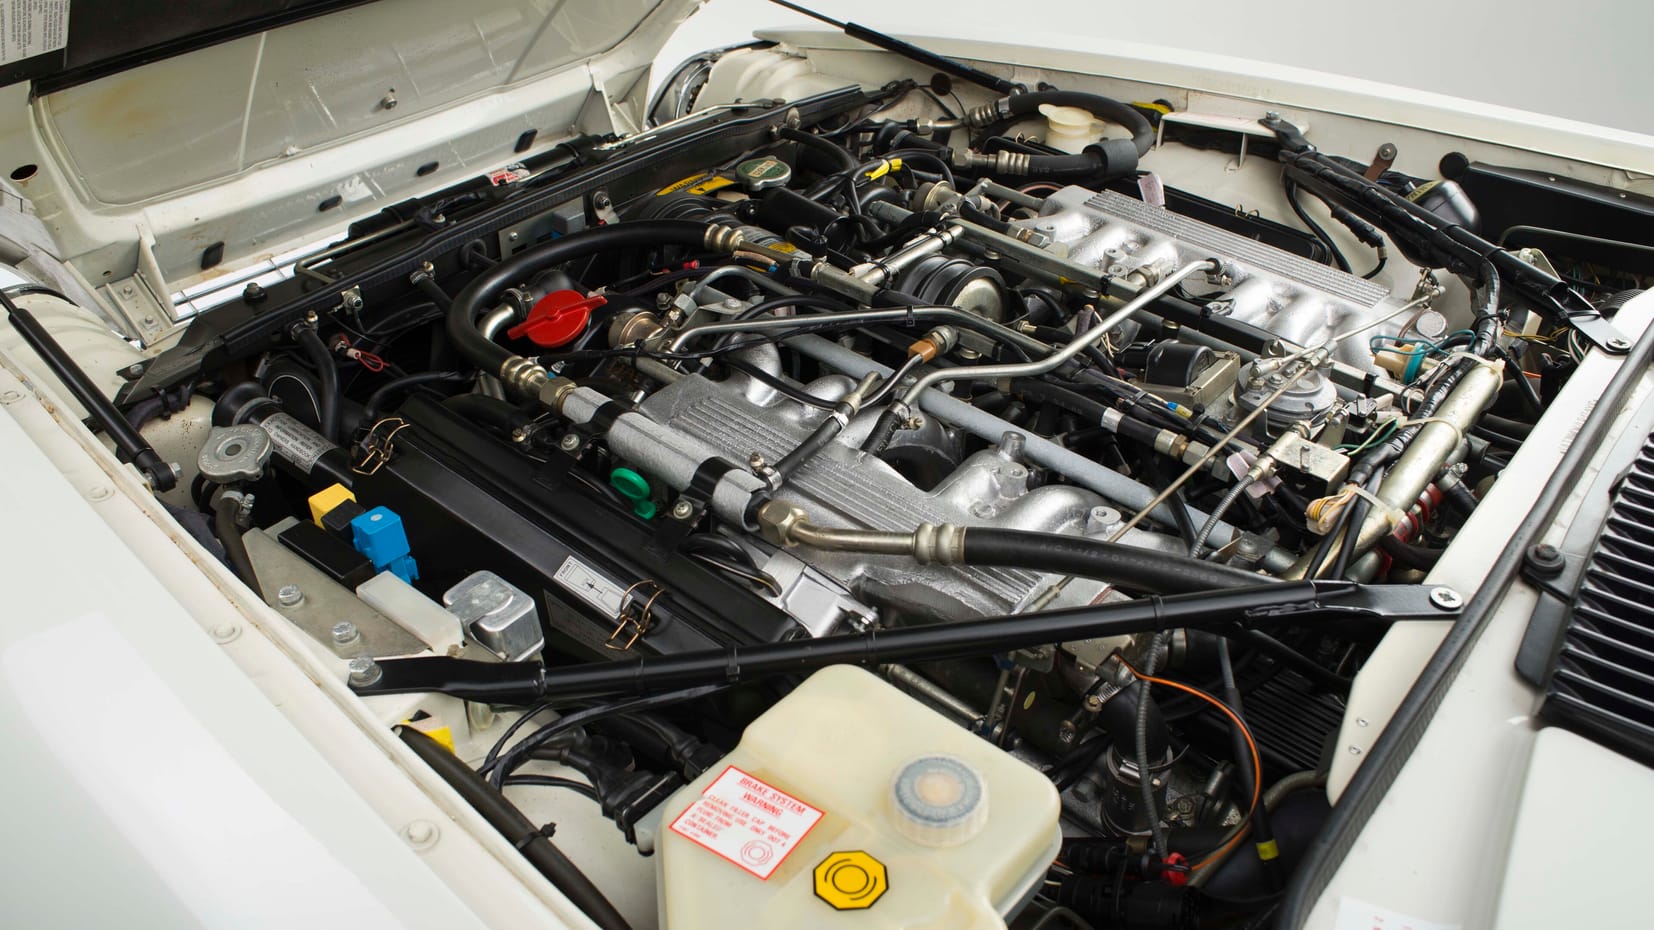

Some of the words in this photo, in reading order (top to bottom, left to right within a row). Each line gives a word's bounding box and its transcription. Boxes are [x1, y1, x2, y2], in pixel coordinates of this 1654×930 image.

[738, 777, 769, 796] BRAKE
[768, 792, 807, 815] SYSTEM
[741, 791, 784, 817] WARNING
[684, 819, 718, 839] CONTAINER
[708, 795, 729, 808] CLEAN
[731, 806, 751, 819] FILLER
[751, 817, 765, 825] CAP
[767, 825, 791, 840] BEFORE
[750, 825, 765, 835] ONLY
